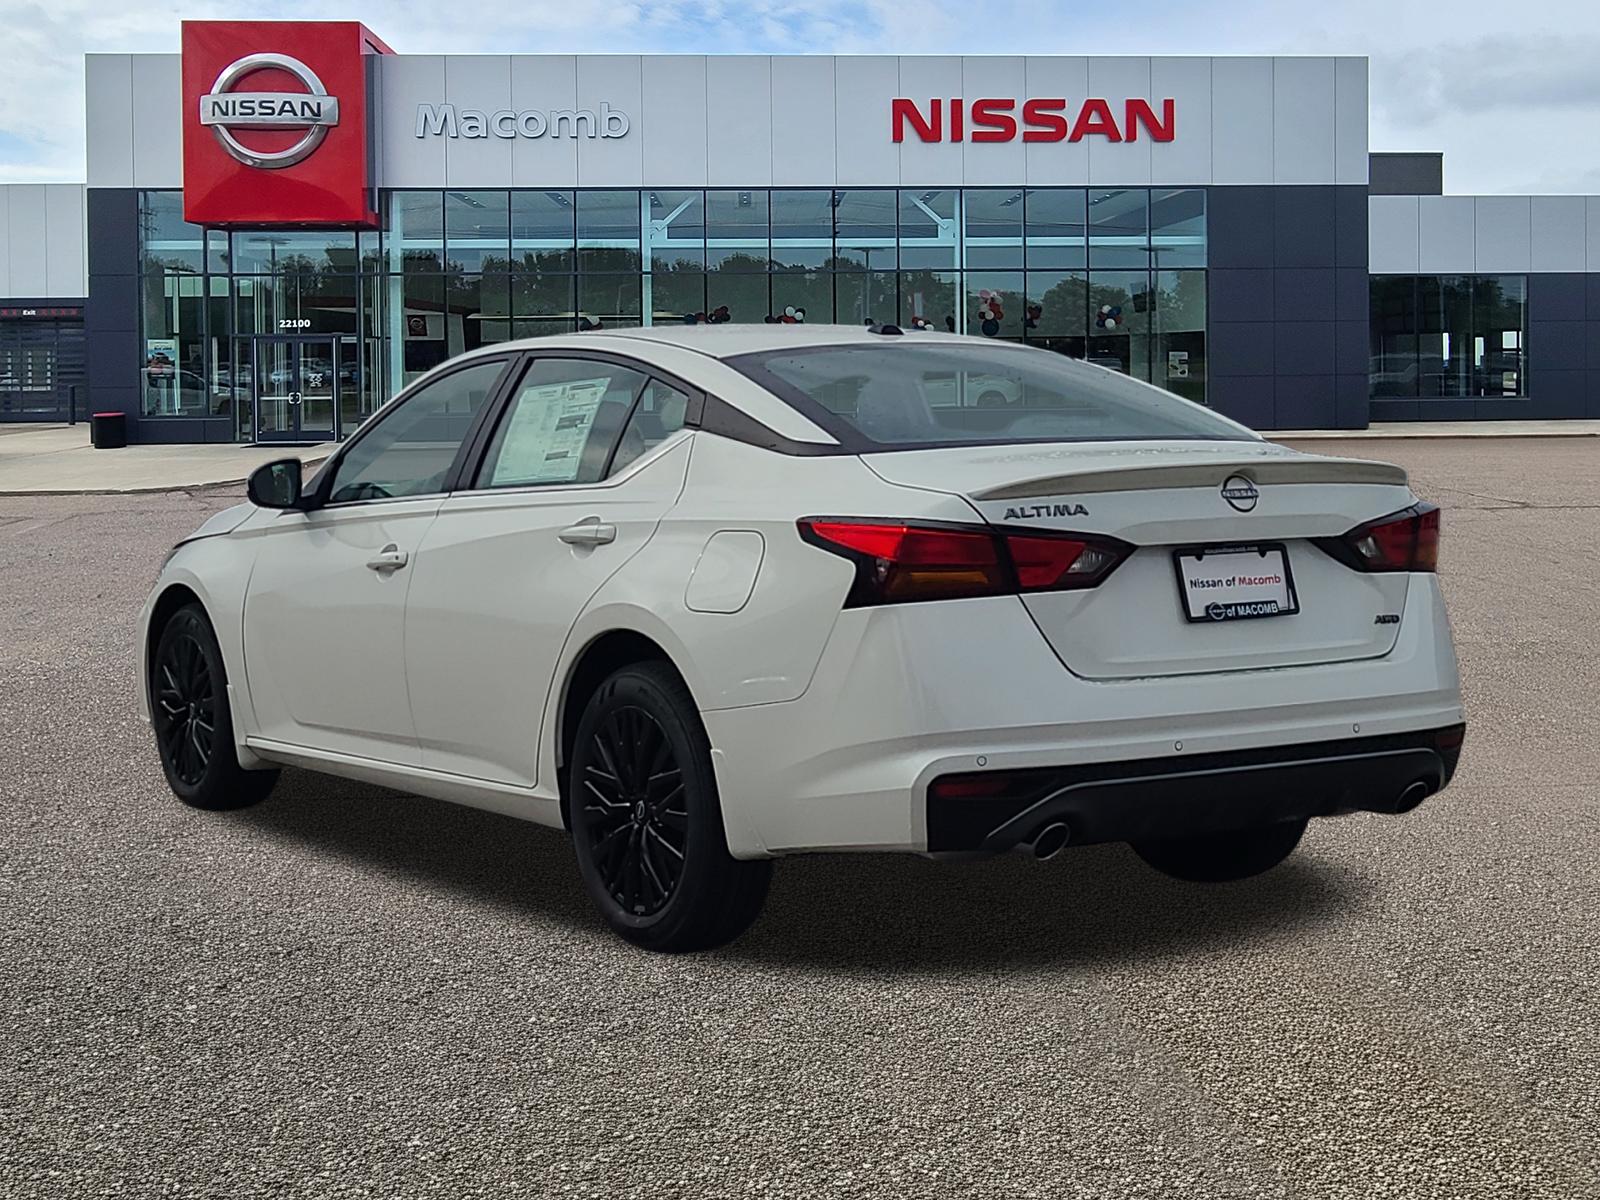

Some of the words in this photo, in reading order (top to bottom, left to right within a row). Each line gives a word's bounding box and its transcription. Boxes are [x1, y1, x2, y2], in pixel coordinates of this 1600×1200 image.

[211, 100, 322, 118] NISSAN
[415, 102, 630, 139] Macomb
[892, 98, 1175, 143] NISSAN
[279, 319, 311, 328] 22100
[1003, 503, 1089, 521] ALTIMA
[1190, 578, 1223, 589] Nissan
[1225, 576, 1236, 587] of
[1238, 574, 1281, 586] Macomb
[1226, 607, 1236, 617] of
[1237, 602, 1279, 616] MACOMB
